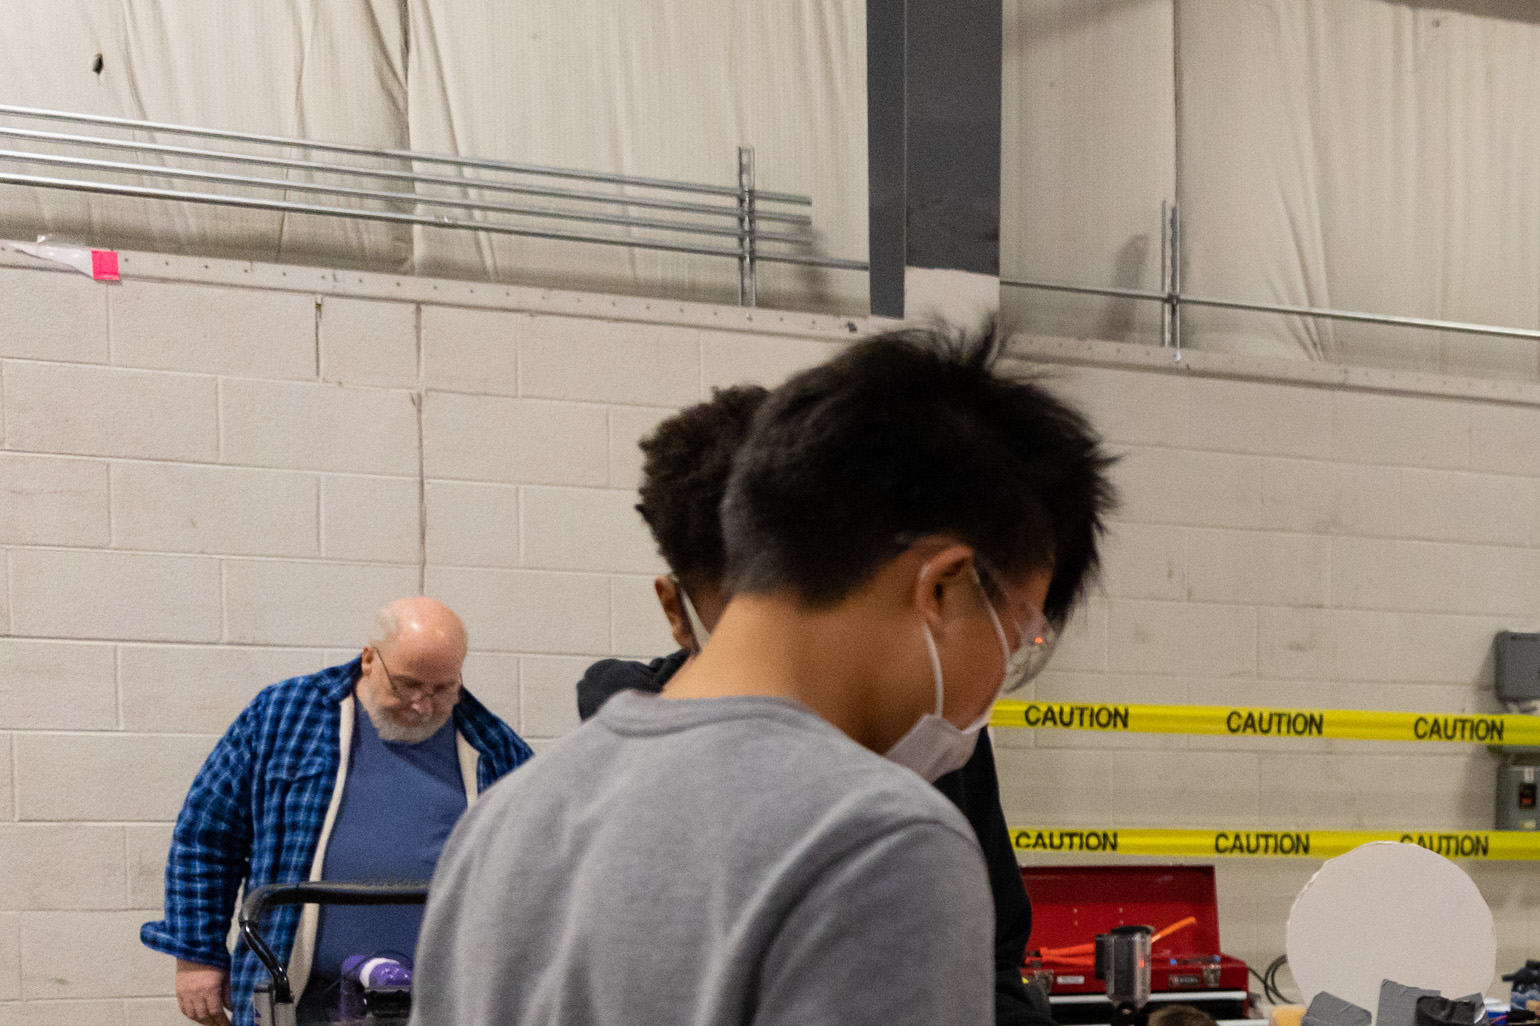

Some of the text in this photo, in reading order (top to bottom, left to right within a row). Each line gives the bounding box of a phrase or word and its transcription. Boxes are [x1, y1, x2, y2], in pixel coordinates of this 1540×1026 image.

[1024, 705, 1129, 728] CAUTION
[1226, 711, 1324, 735] CAUTION
[1414, 717, 1504, 741] CAUTION
[1015, 831, 1118, 851] CAUTION
[1214, 833, 1310, 855] CAUTION
